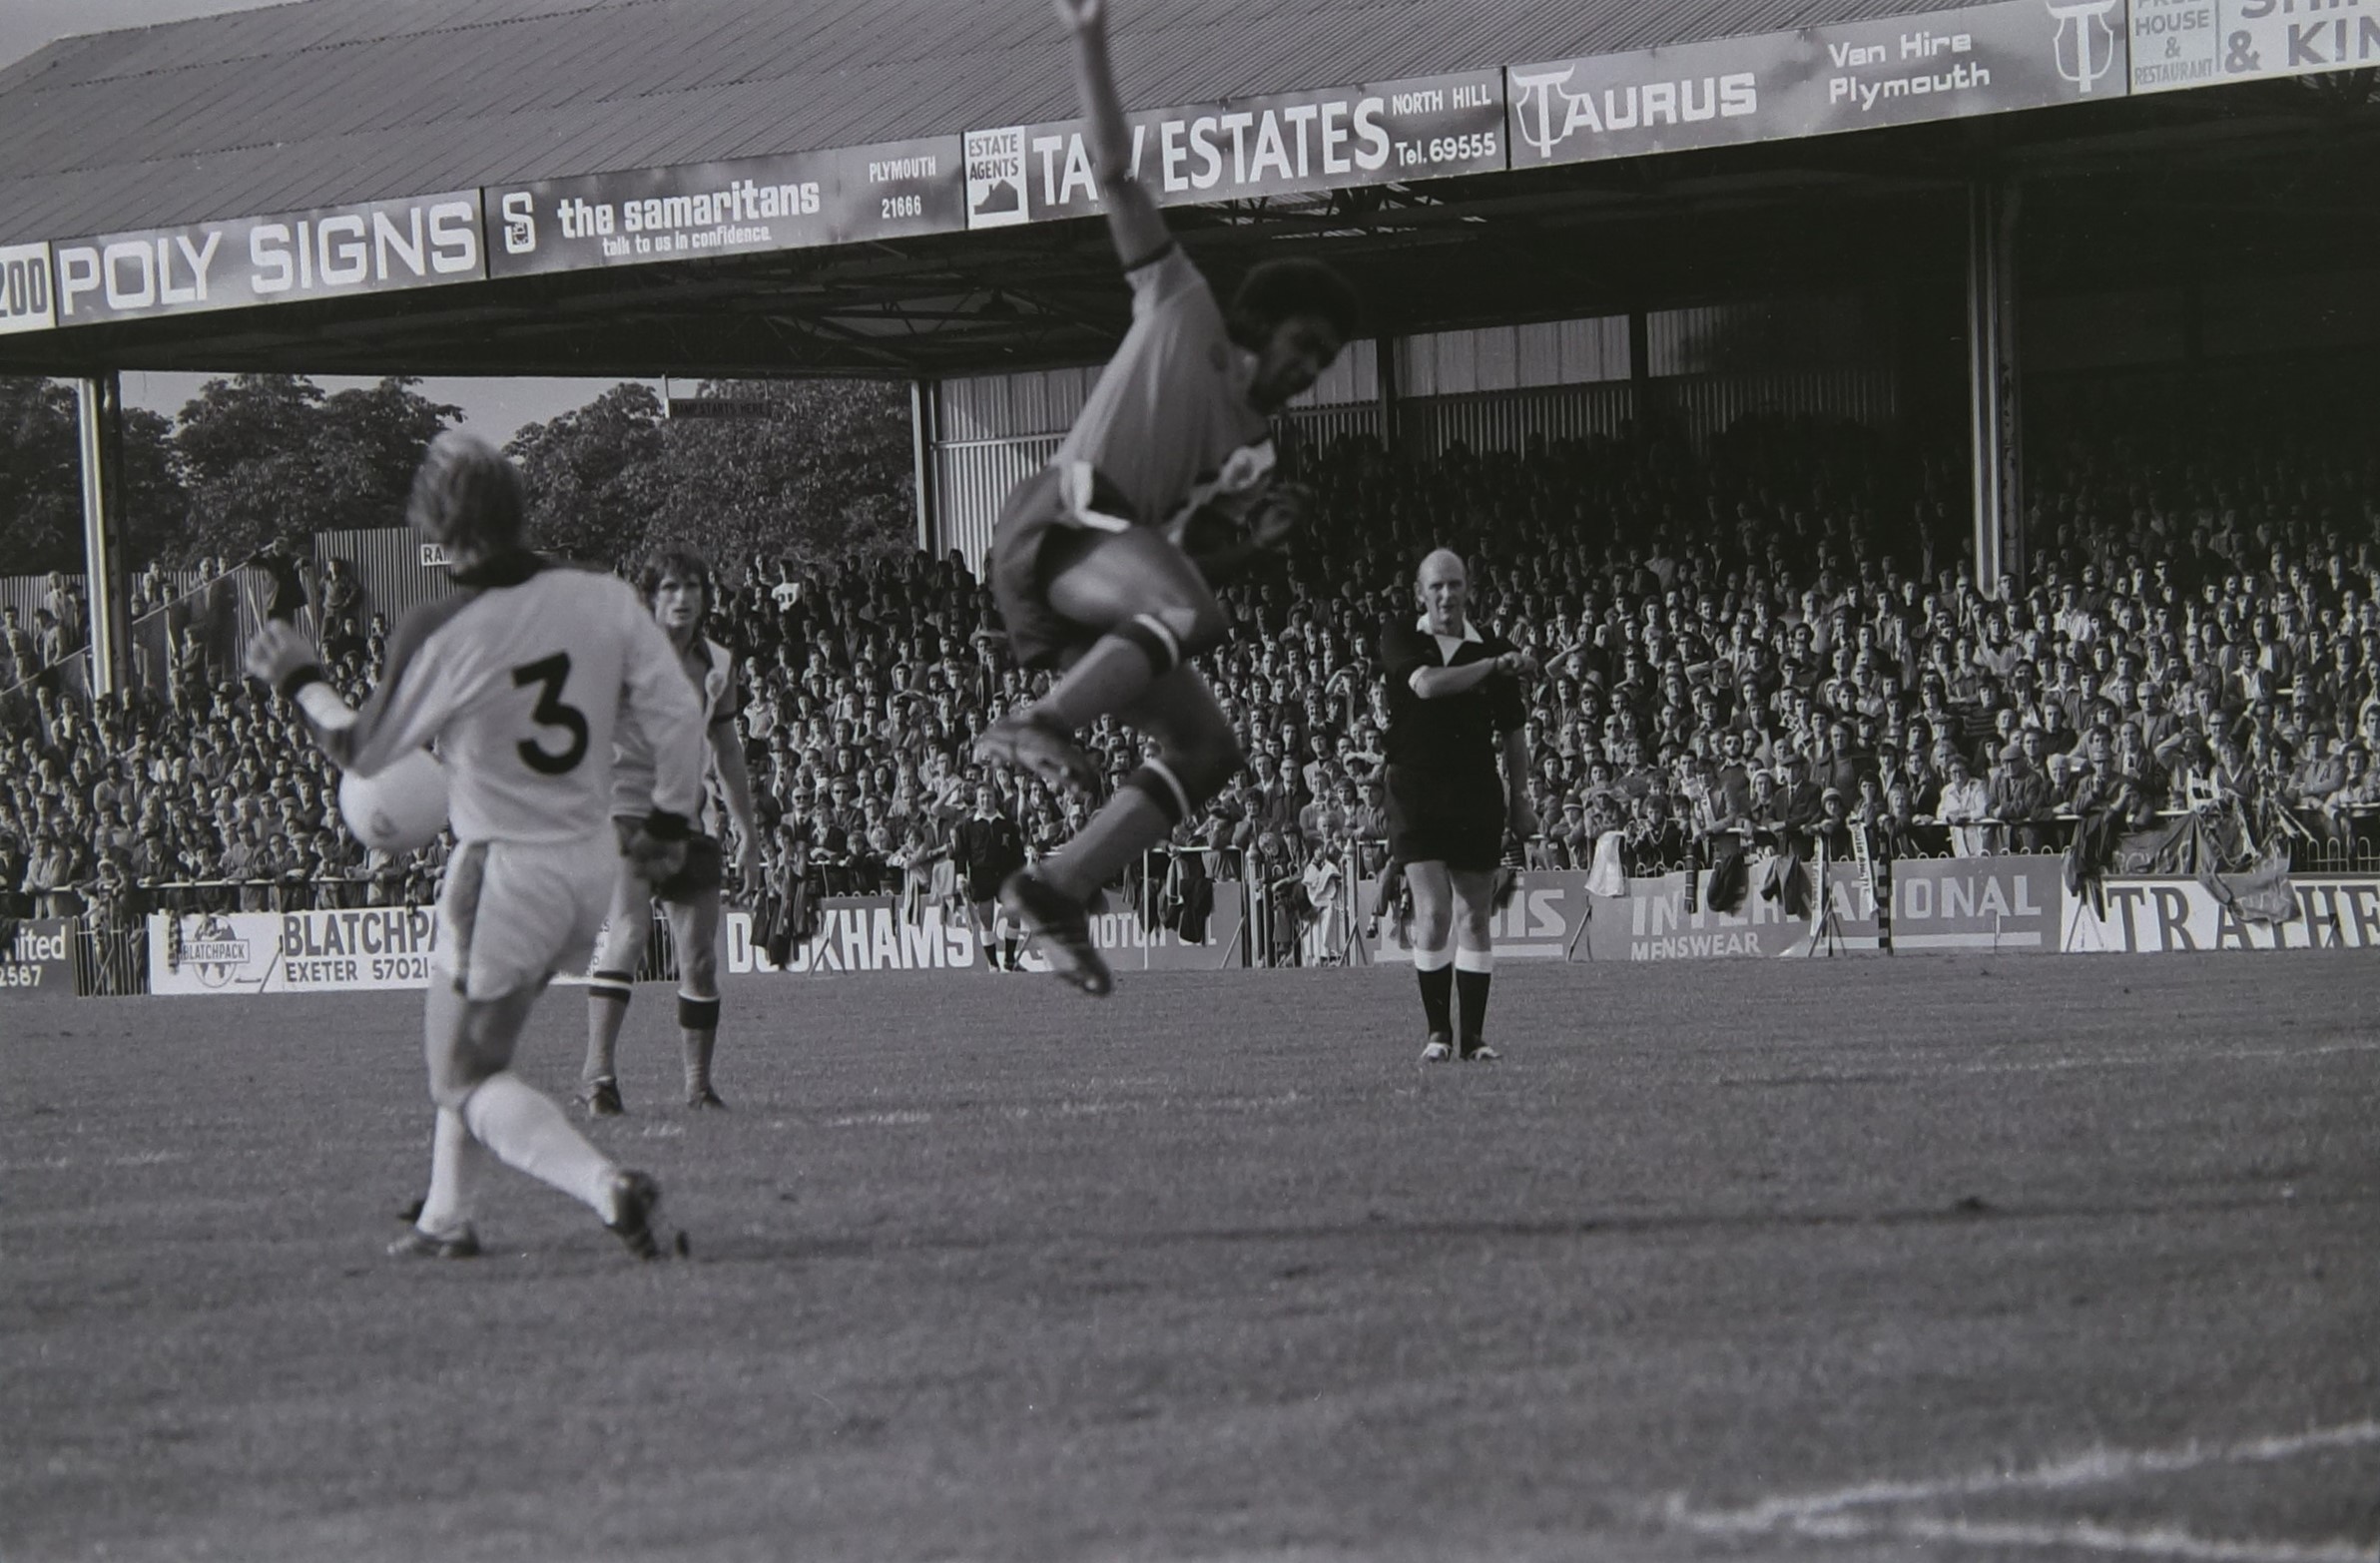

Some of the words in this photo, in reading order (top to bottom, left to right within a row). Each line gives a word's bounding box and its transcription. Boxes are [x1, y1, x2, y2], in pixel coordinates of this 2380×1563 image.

[2134, 9, 2209, 36] HOUSE
[1828, 44, 1886, 68] Van
[1900, 32, 1973, 59] Hire
[2164, 36, 2180, 58] &
[2224, 30, 2261, 73] &
[1829, 63, 1991, 111] Plymouth
[2134, 58, 2212, 85] RESTAURANT
[1392, 90, 1444, 116] NORTH
[1453, 84, 1492, 108] HILL
[1511, 64, 1757, 158] TAURUS
[968, 134, 1018, 158] ESTATE
[1160, 97, 1390, 193] ESTATES
[1396, 140, 1429, 168] Tel.
[1430, 132, 1496, 163] 69555
[869, 156, 937, 184] PLYMOUTH
[969, 158, 1018, 182] AGENTS
[557, 199, 614, 240] the
[625, 180, 821, 233] samaritans
[881, 195, 922, 220] 21666
[602, 236, 631, 257] talk
[635, 234, 650, 254] to
[654, 235, 672, 252] us
[675, 231, 689, 250] in
[692, 225, 772, 249] confidence.
[59, 230, 223, 315] POLY
[250, 201, 477, 294] SIGNS
[512, 651, 589, 776] 3
[182, 942, 245, 960] BLATCHPACK
[1630, 931, 1760, 961] MENSWEAR
[286, 959, 357, 982] EXETER
